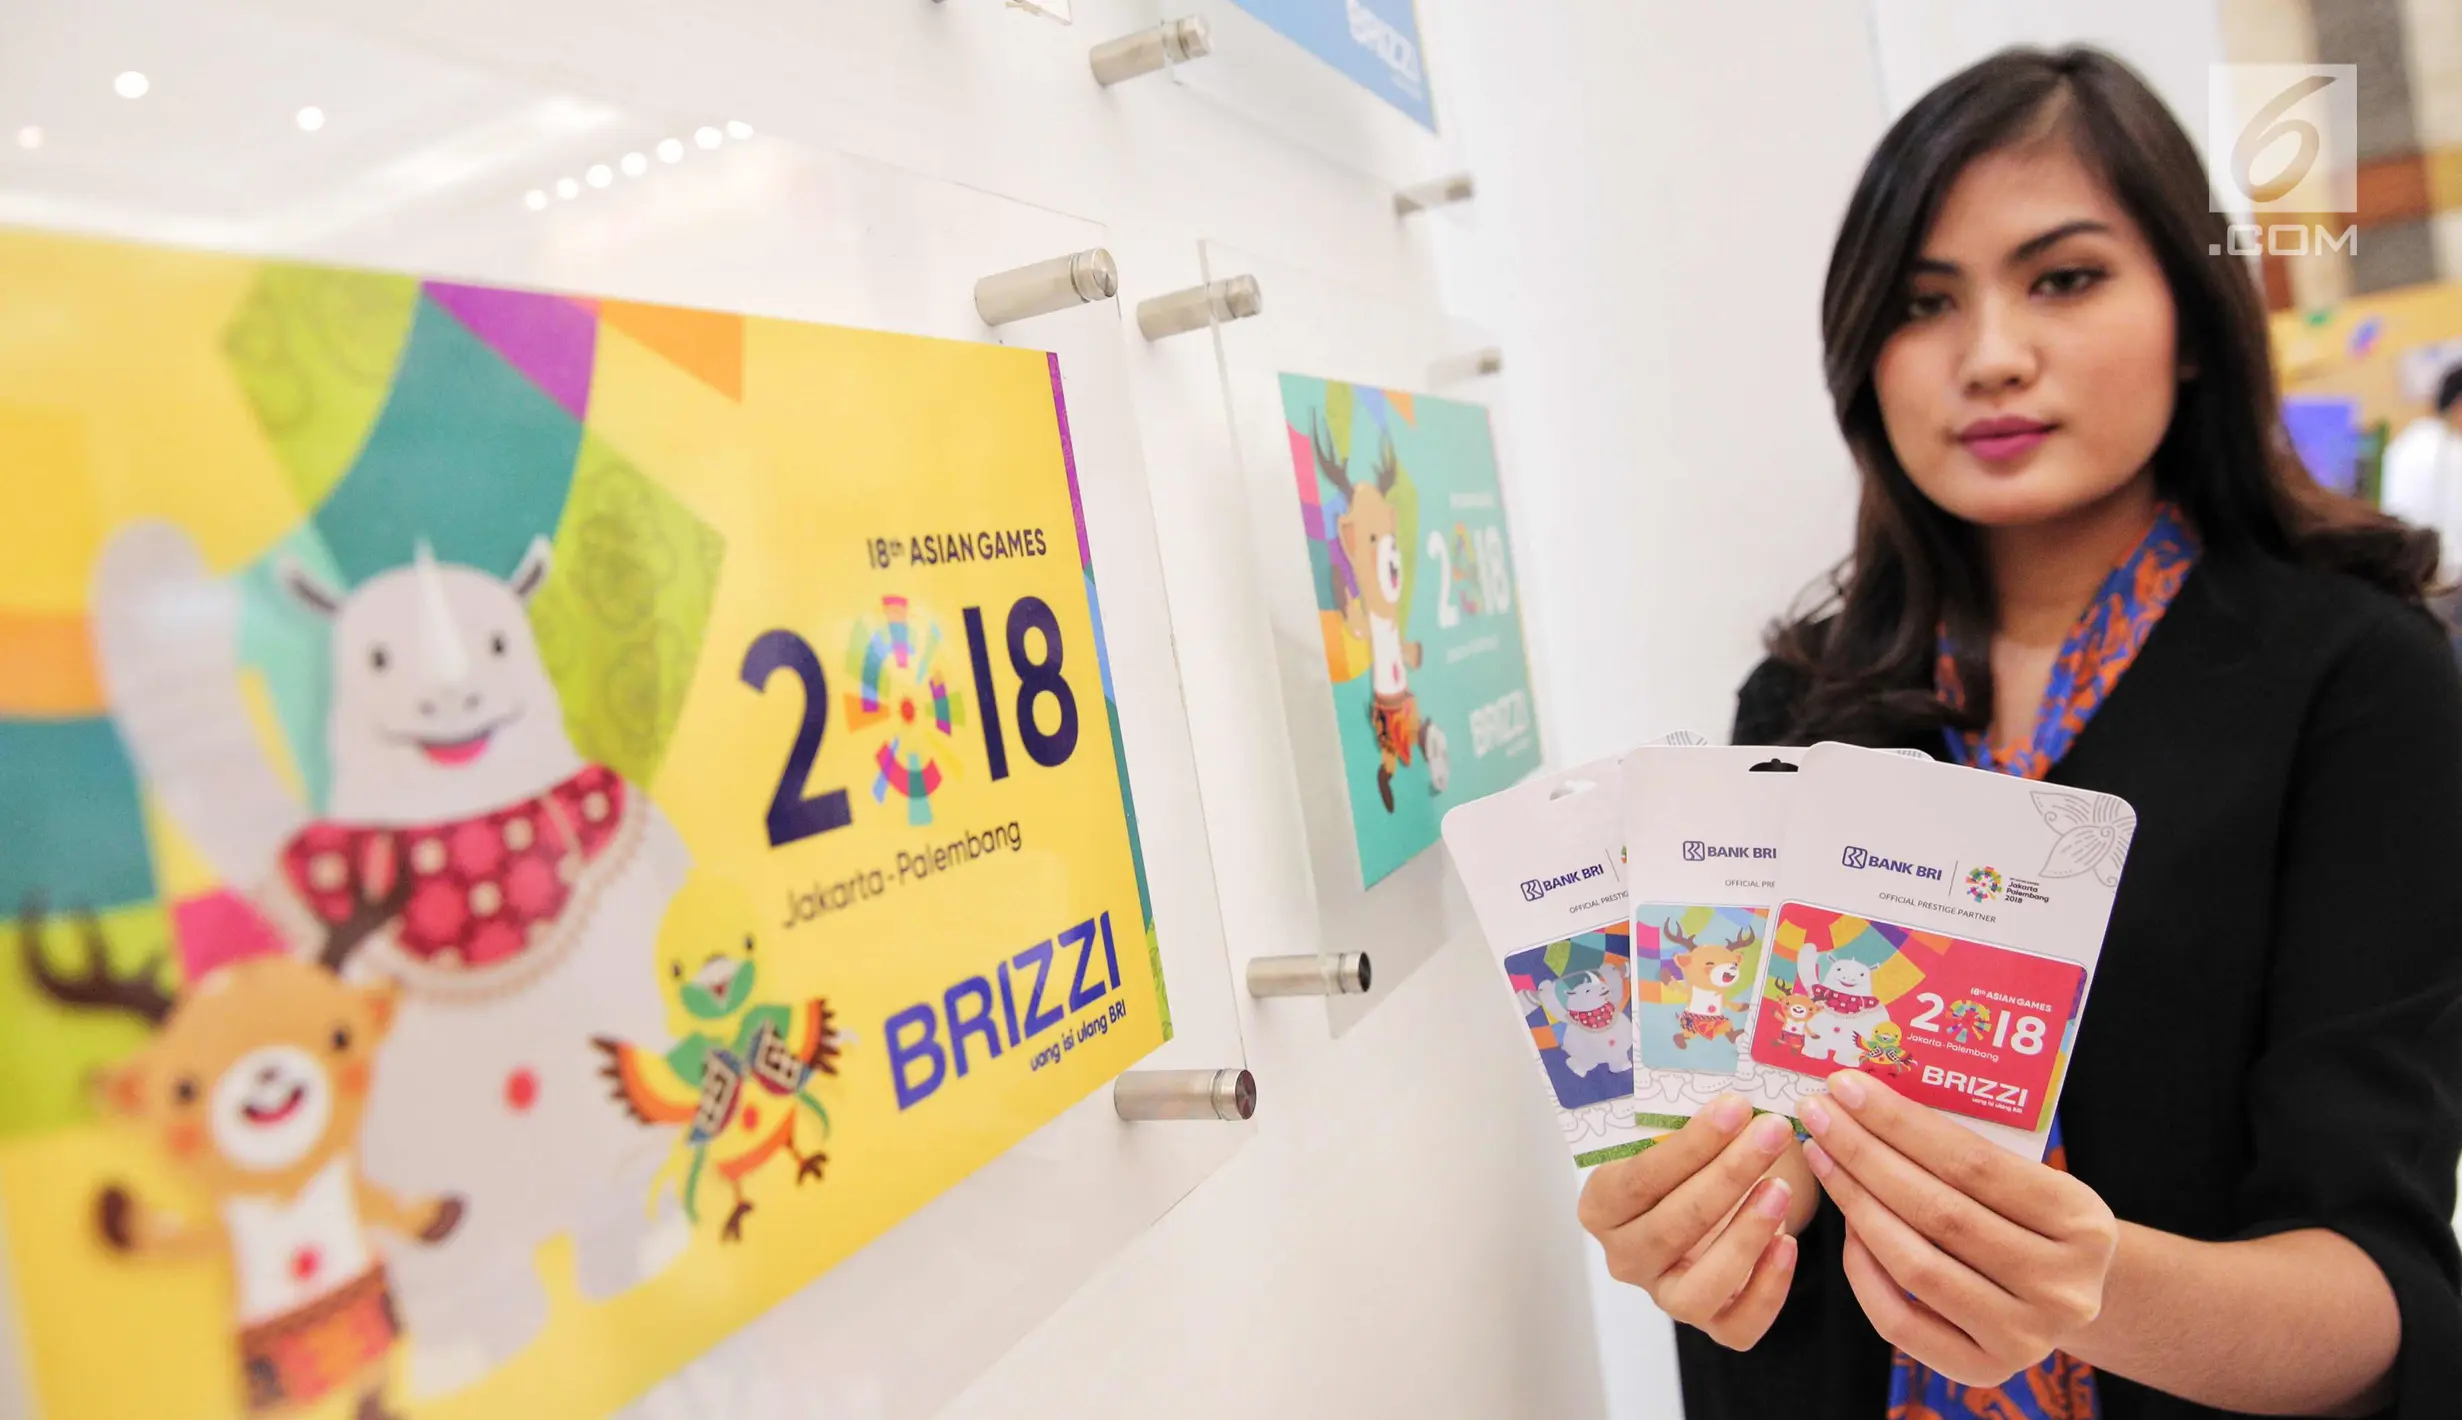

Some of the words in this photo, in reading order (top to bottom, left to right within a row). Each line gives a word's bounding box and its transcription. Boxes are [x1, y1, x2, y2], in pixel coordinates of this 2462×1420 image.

[911, 533, 975, 567] ASIAN
[977, 527, 1047, 561] GAMES
[1707, 846, 1750, 859] BANK
[1752, 847, 1777, 860] BRI
[1541, 871, 1581, 892] BANK
[1581, 863, 1605, 880] BRI
[1868, 855, 1914, 875] BANK
[1915, 865, 1943, 882] BRI
[1724, 879, 1760, 888] OFFICIAL
[2006, 887, 2050, 904] Palembang
[2008, 881, 2039, 893] Jakarta
[1568, 900, 1601, 914] OFFICIAL
[1878, 892, 1916, 907] OFFICIAL
[1917, 900, 1957, 915] PRESTIGE
[1957, 908, 1998, 924] PARTNER
[884, 911, 1122, 1112] BRIZZI
[1986, 991, 2016, 1005] ASIAN
[2016, 997, 2053, 1014] GAMES
[1030, 1042, 1061, 1072] uang
[1061, 1028, 1075, 1053] isi
[1077, 1014, 1108, 1044] ulang
[1108, 998, 1127, 1024] BRI
[1921, 1064, 2029, 1108] BRIZZI
